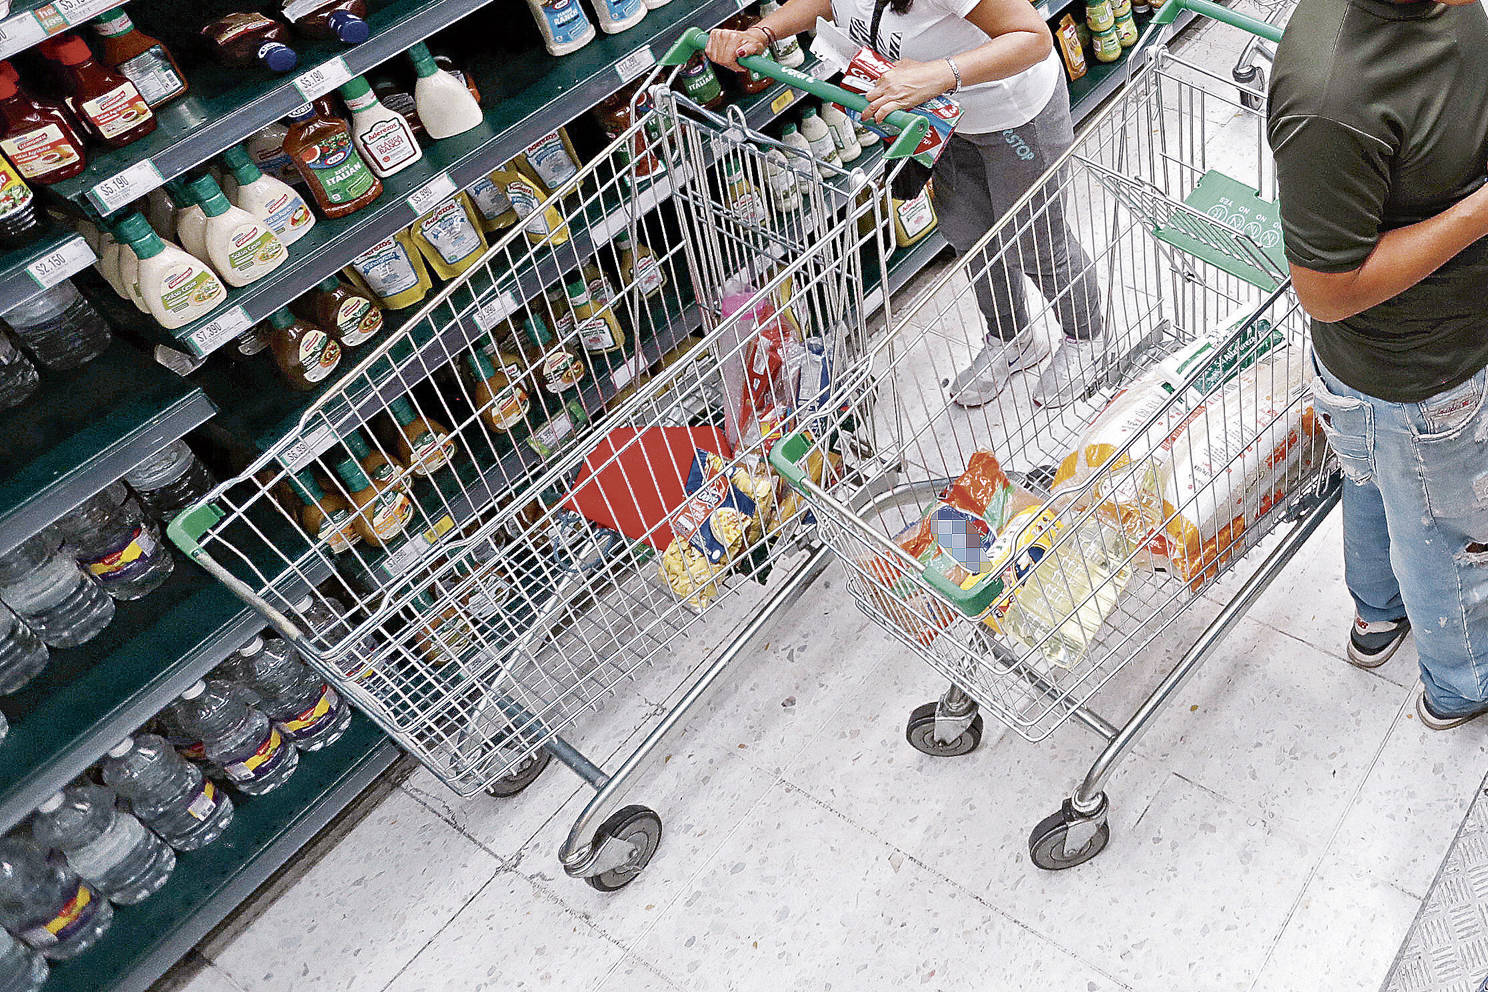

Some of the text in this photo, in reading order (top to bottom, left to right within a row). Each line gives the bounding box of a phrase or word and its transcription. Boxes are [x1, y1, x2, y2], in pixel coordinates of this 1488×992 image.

[301, 70, 325, 89] $5.190
[368, 122, 398, 142] Aderezos
[100, 174, 130, 197] $5.190
[326, 162, 363, 187] ITALIAN
[34, 250, 66, 279] $2.150
[198, 321, 223, 343] $7.390
